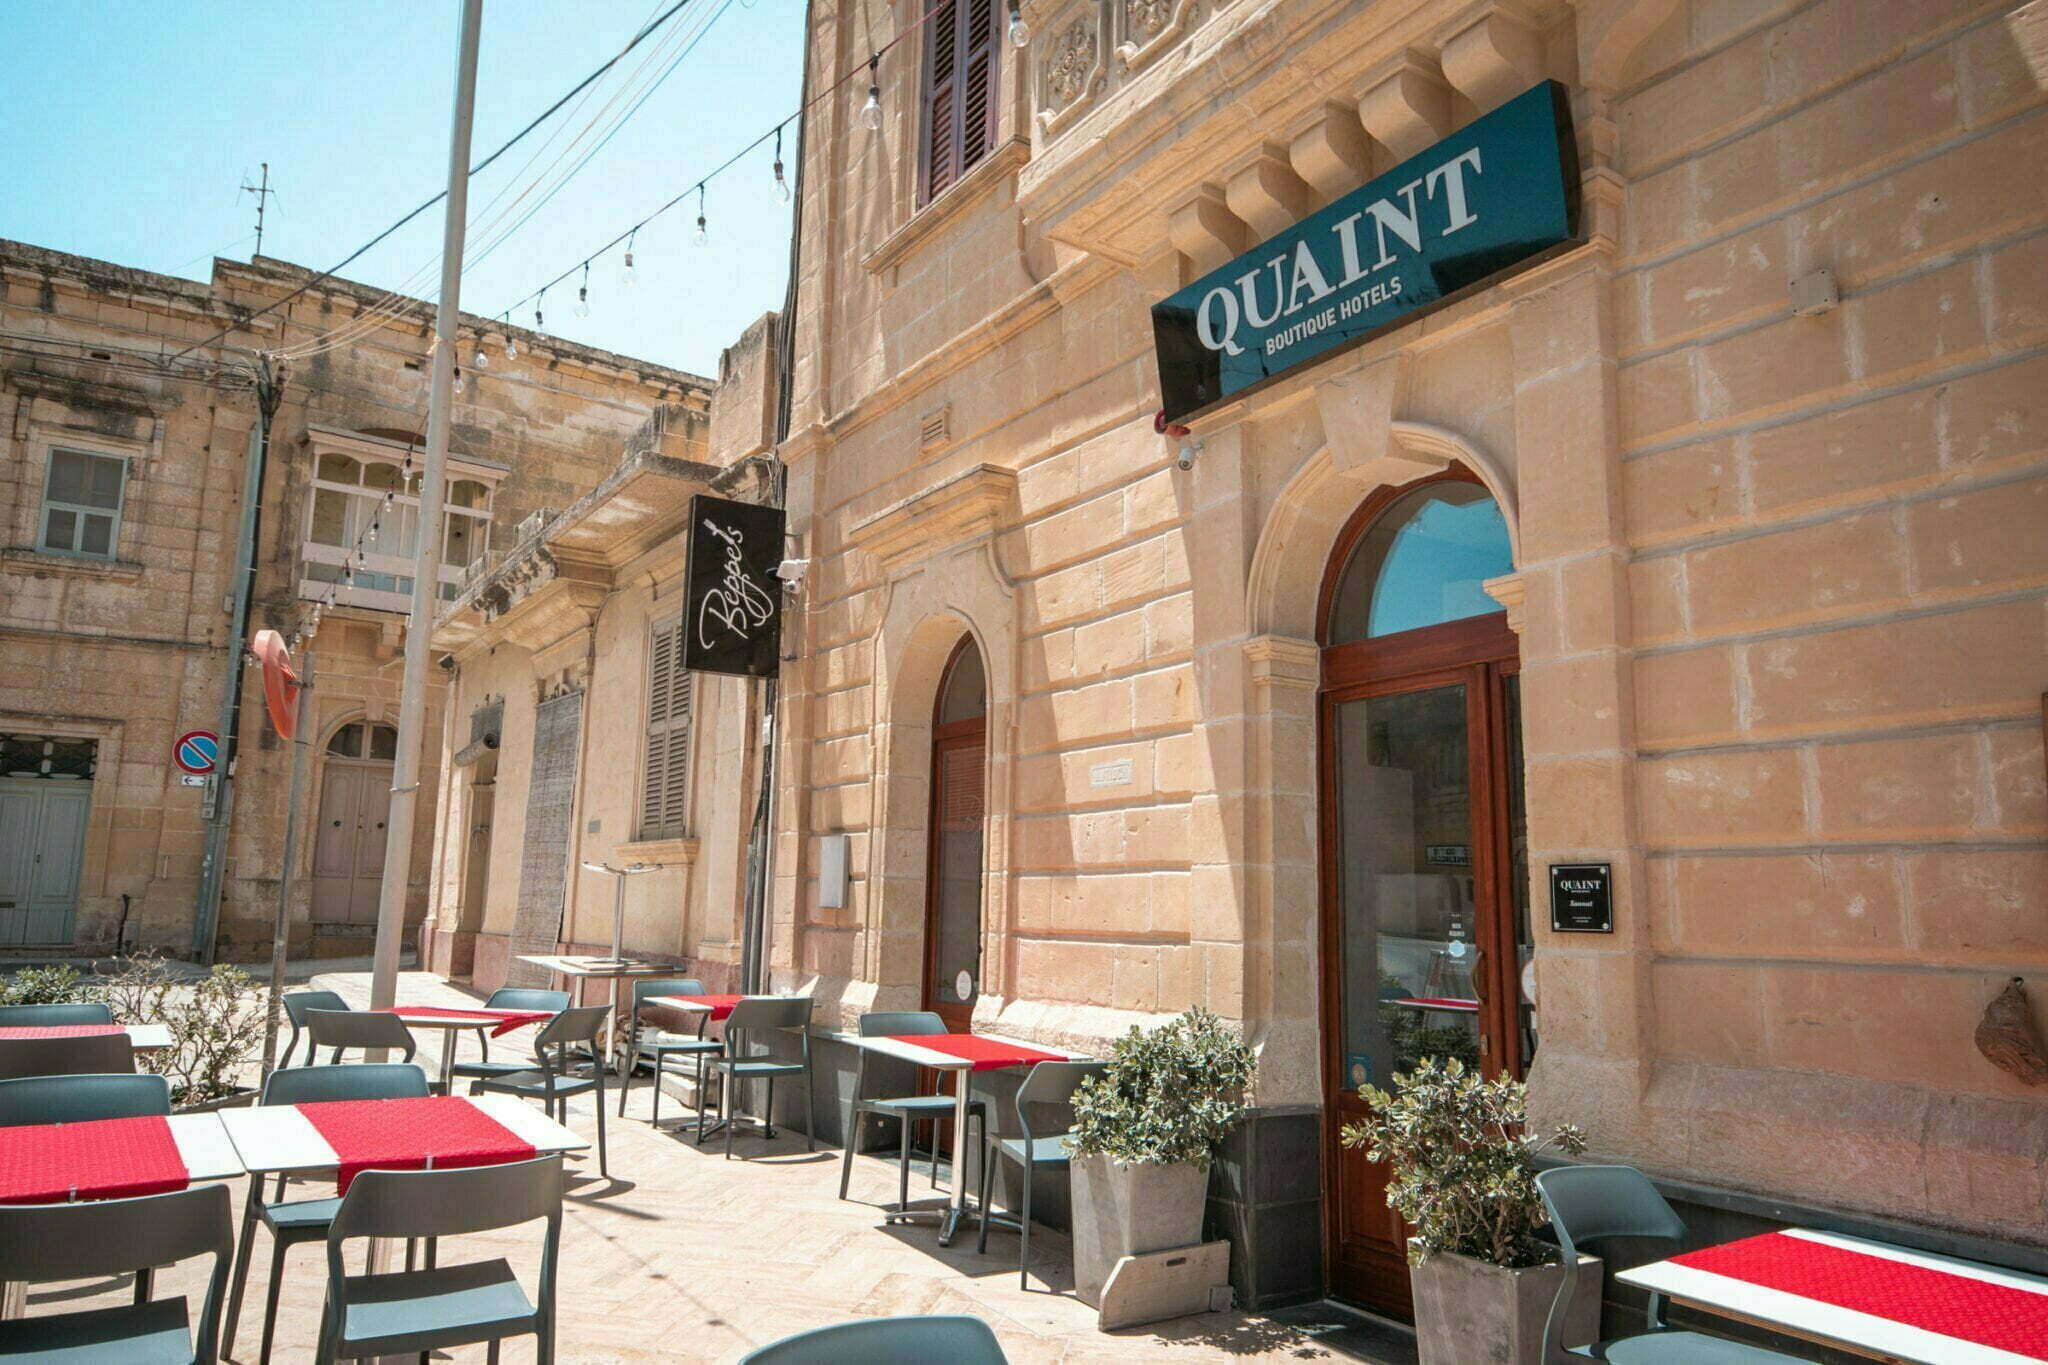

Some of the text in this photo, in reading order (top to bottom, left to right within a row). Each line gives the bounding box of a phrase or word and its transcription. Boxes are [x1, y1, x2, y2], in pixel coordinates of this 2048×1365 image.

[1196, 146, 1483, 356] QUAINT
[1265, 276, 1402, 356] BOUTIQUE HOTELS
[1560, 880, 1601, 891] QUAINT
